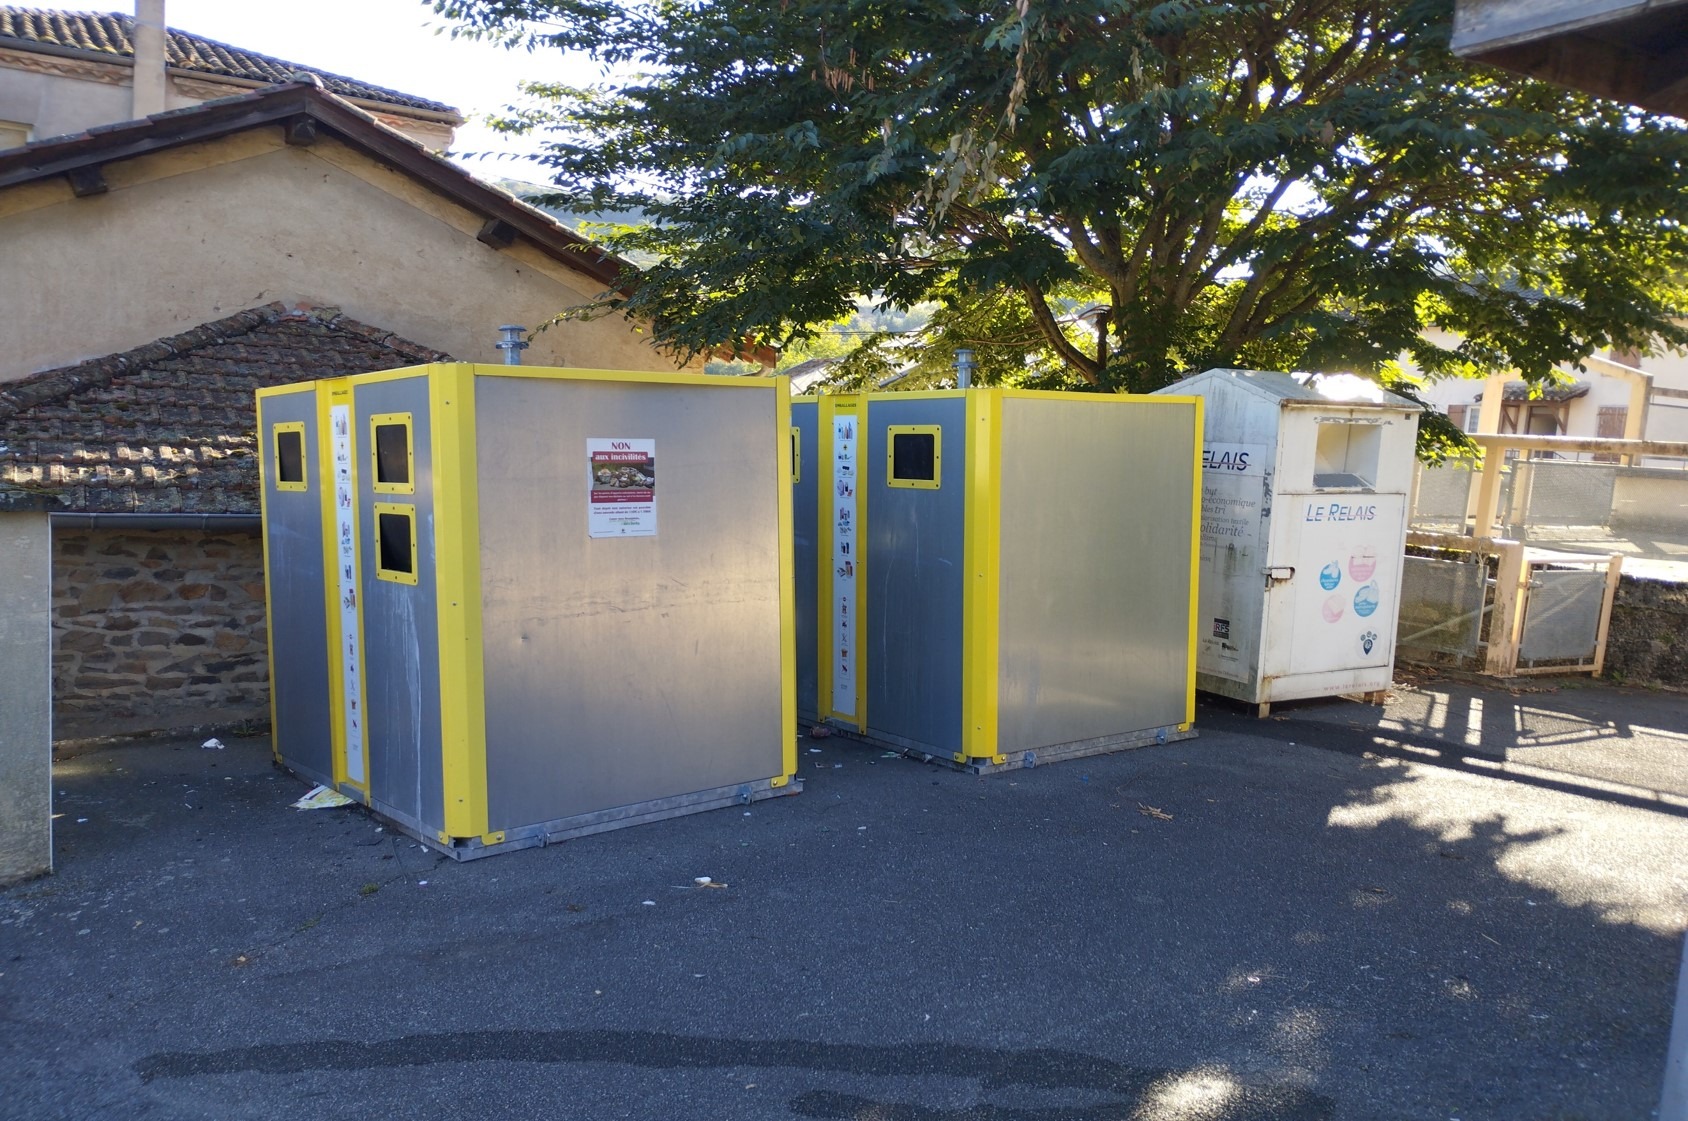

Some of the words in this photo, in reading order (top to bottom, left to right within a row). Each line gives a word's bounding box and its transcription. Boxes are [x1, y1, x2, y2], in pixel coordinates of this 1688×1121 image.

[611, 442, 631, 450] NON
[610, 453, 647, 461] incivilités
[1202, 450, 1250, 471] ELAIS
[1201, 496, 1256, 508] o-économique
[1306, 503, 1325, 521] LE
[1327, 503, 1377, 521] RELAIS
[1200, 521, 1244, 537] olidarité
